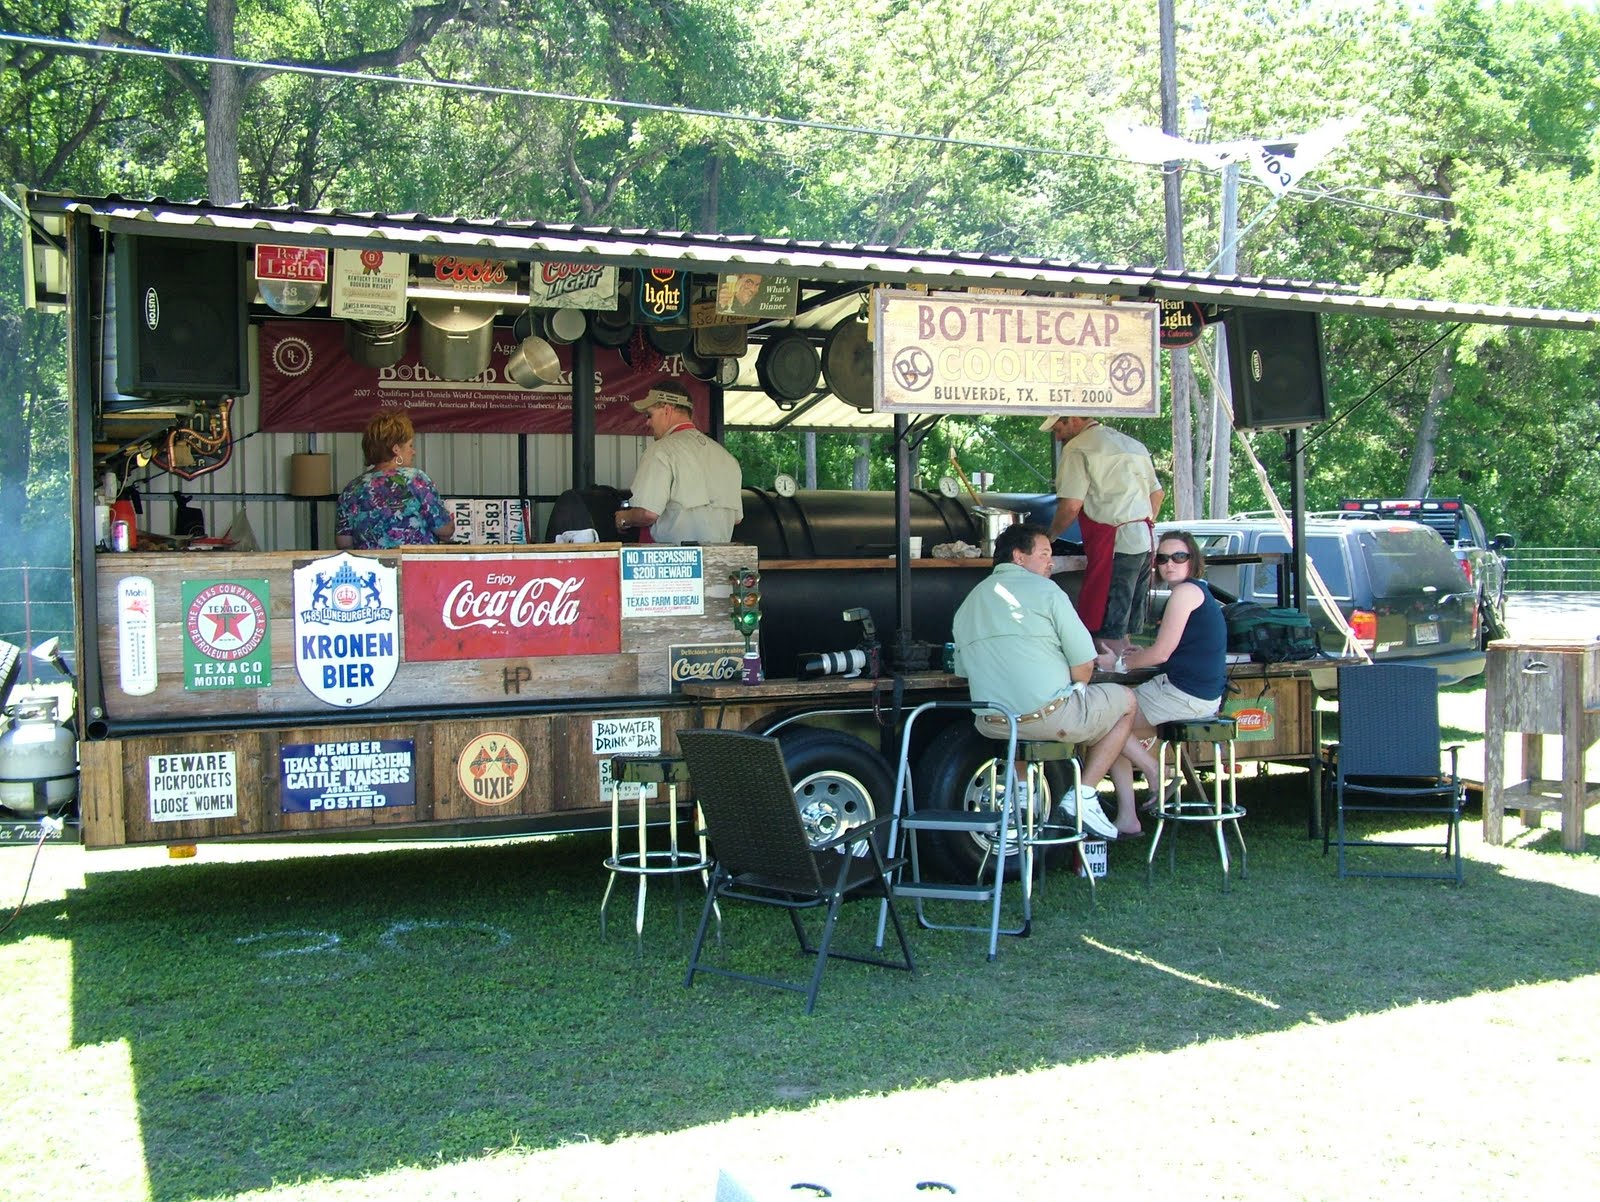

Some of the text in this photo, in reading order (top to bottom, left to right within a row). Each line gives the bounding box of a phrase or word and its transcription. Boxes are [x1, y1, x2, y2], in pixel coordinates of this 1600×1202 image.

[267, 259, 317, 279] Light
[433, 255, 508, 284] Coors
[546, 271, 603, 301] LIGHT
[766, 285, 791, 293] What's
[775, 277, 788, 285] It's
[283, 287, 298, 297] 68
[645, 283, 680, 315] light
[770, 295, 784, 303] For
[148, 293, 157, 325] KUSTOM
[760, 303, 788, 311] Dinner
[918, 305, 1120, 347] BOTTLECAP
[1160, 311, 1193, 330] ight
[938, 347, 1107, 386] COOKERS
[377, 390, 410, 398] Qualifiers
[411, 390, 425, 399] Jack
[474, 392, 520, 402] Championship
[935, 386, 1113, 404] BULVERDE, TX. EST. 2000
[404, 401, 437, 409] Qualifiers
[437, 401, 469, 409] American
[470, 402, 488, 410] Royal
[627, 550, 698, 564] NO TRESPASSING
[486, 573, 516, 586] Enjoy
[633, 566, 693, 579] $200 REWARD
[126, 589, 148, 597] Mobil
[626, 595, 699, 608] TEXAS FARM BUREAU
[188, 611, 198, 626] THE
[193, 588, 216, 610] TEXAS
[220, 585, 257, 604] COMPANY
[208, 605, 248, 614] TEXACO
[442, 577, 586, 630] Coca-Cola
[303, 611, 321, 622] 1485
[373, 609, 391, 620] 1485
[190, 627, 264, 659] PETROLEUM PRODUCTS
[303, 633, 393, 660] KRONEN
[194, 662, 263, 675] TEXACO
[323, 664, 375, 689] BIER
[194, 675, 263, 687] MOTOR OIL
[597, 721, 656, 737] BAD WATER
[314, 741, 381, 757] MEMBER
[596, 736, 628, 751] DRINK
[637, 734, 658, 748] BAR
[159, 755, 227, 774] BEWARE
[283, 752, 411, 774] TEXAS & SOUTHWESTERN
[155, 772, 232, 791] PICKPOCKETS
[287, 768, 410, 790] CATTLE RAISERS
[474, 777, 514, 800] DIXIE
[154, 794, 233, 814] LOOSE WOMEN
[310, 795, 386, 811] POSTED
[0, 825, 12, 839] ex
